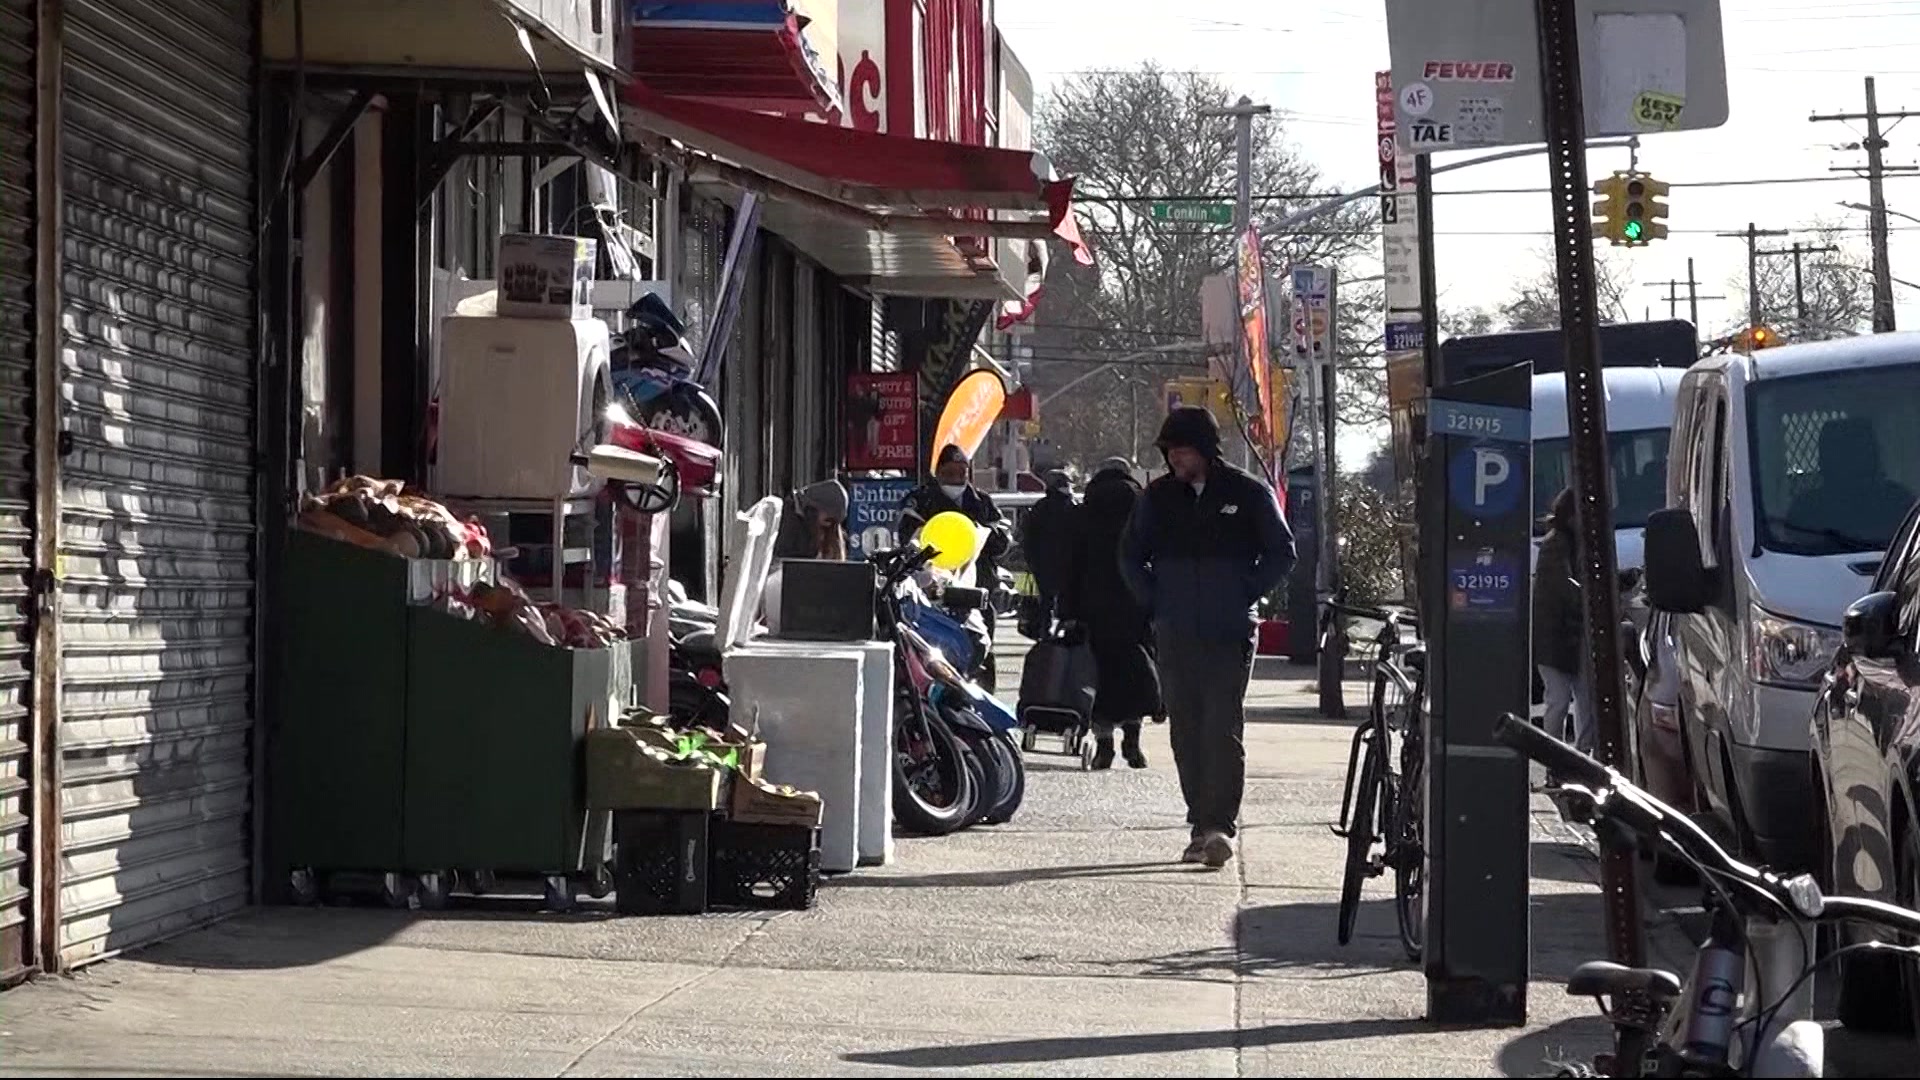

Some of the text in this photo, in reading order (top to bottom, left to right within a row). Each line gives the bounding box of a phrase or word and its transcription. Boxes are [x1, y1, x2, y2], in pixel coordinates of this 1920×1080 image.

[1424, 61, 1515, 81] FEWER
[1411, 125, 1450, 143] TAE
[1166, 205, 1208, 220] Conklin
[880, 397, 912, 409] SUITS
[884, 415, 906, 426] GET
[1447, 414, 1501, 433] 321915
[878, 445, 913, 458] FREE
[1474, 450, 1510, 505] P
[857, 503, 900, 522] Stor
[1457, 575, 1509, 589] 321915
